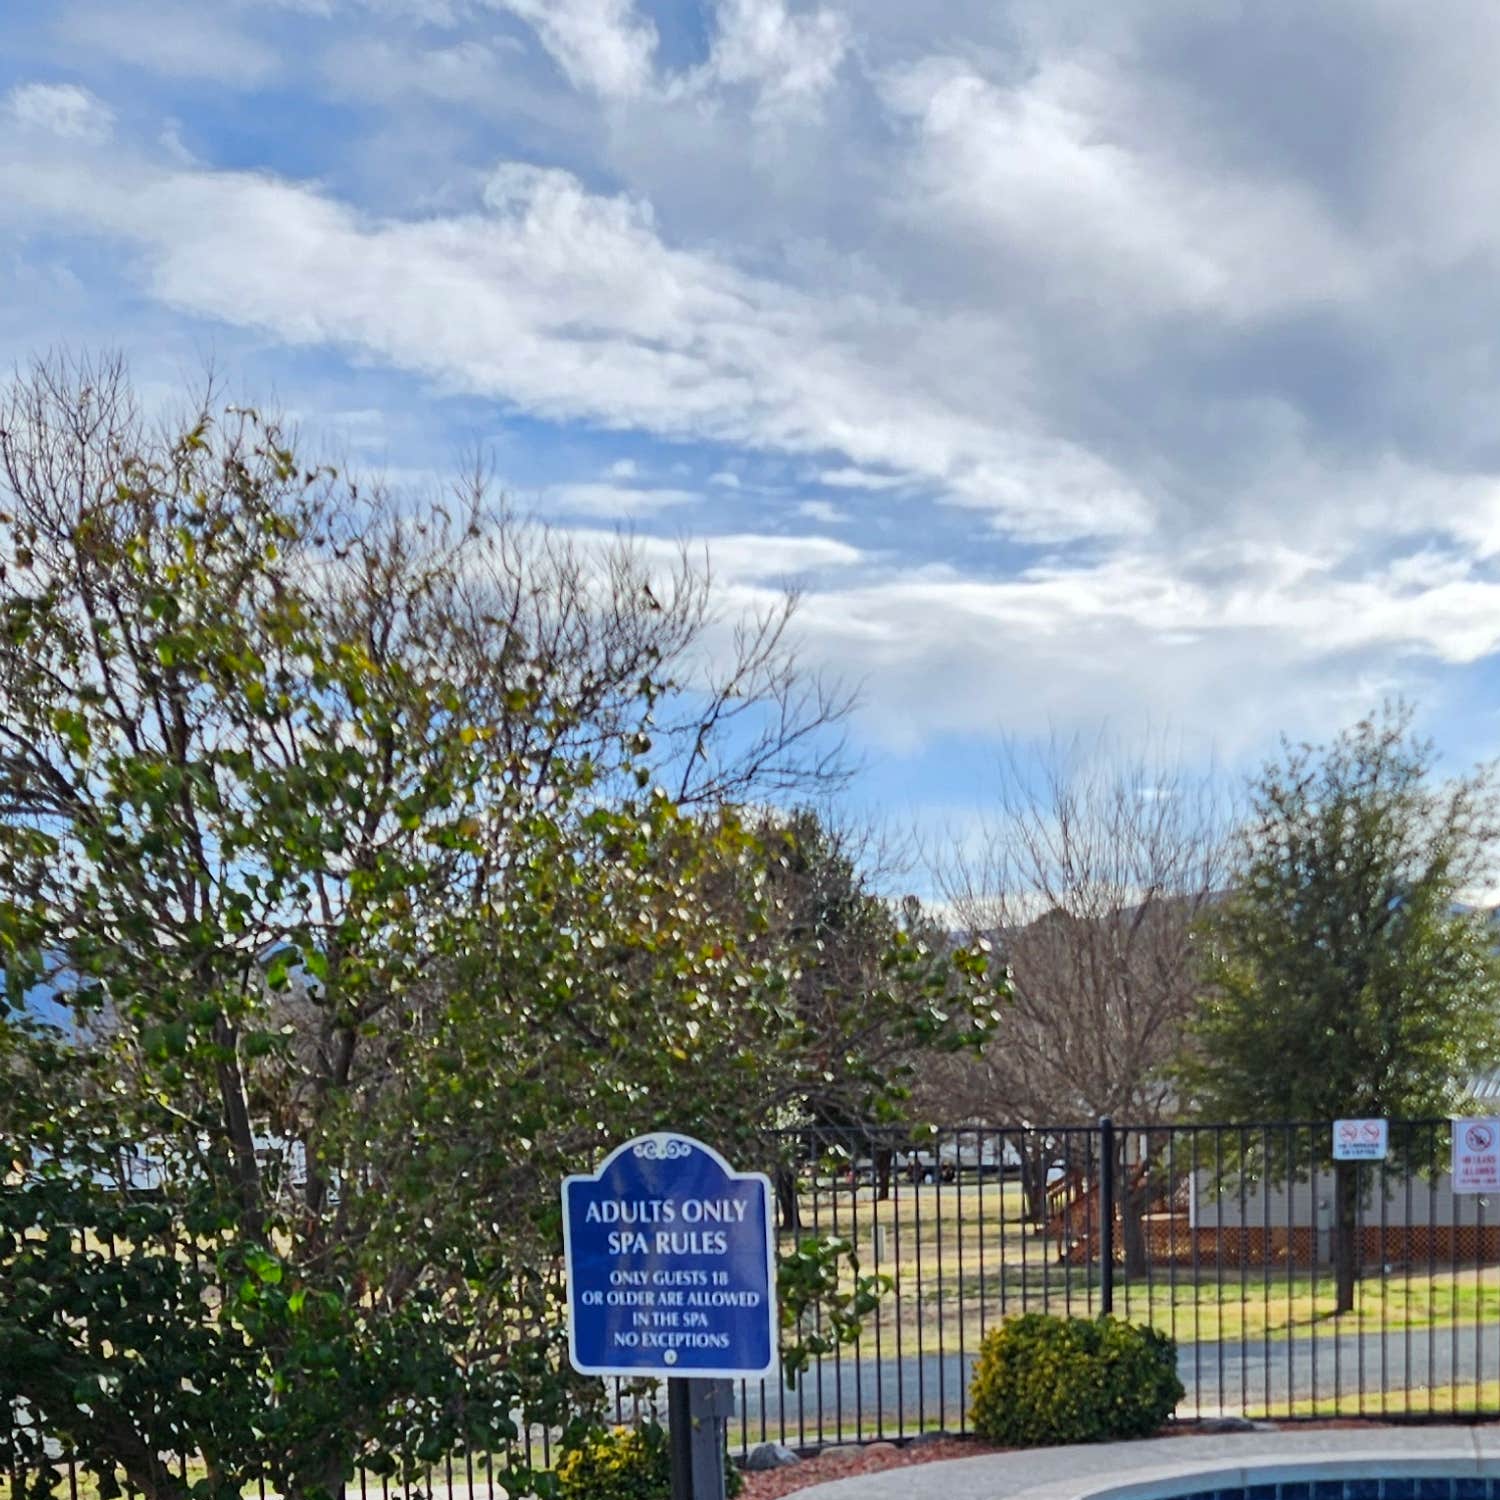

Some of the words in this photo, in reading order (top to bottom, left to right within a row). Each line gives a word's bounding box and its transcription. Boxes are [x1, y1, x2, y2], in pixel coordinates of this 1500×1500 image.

[585, 1199, 675, 1224] ADULTS
[681, 1199, 748, 1224] ONLY
[608, 1231, 649, 1255] SPA
[655, 1231, 728, 1255] RULES
[609, 1270, 649, 1286] ONLY
[652, 1270, 708, 1287] GUESTS
[711, 1271, 729, 1287] 18
[581, 1289, 604, 1306] OR
[606, 1289, 654, 1307] OLDER
[656, 1290, 684, 1307] ARE
[686, 1291, 760, 1308] ALLOWED
[632, 1311, 651, 1327] IN
[652, 1311, 680, 1327] THE
[682, 1311, 709, 1327] SPA
[613, 1332, 639, 1348] NO
[641, 1332, 730, 1349] EXCEPTIONS
